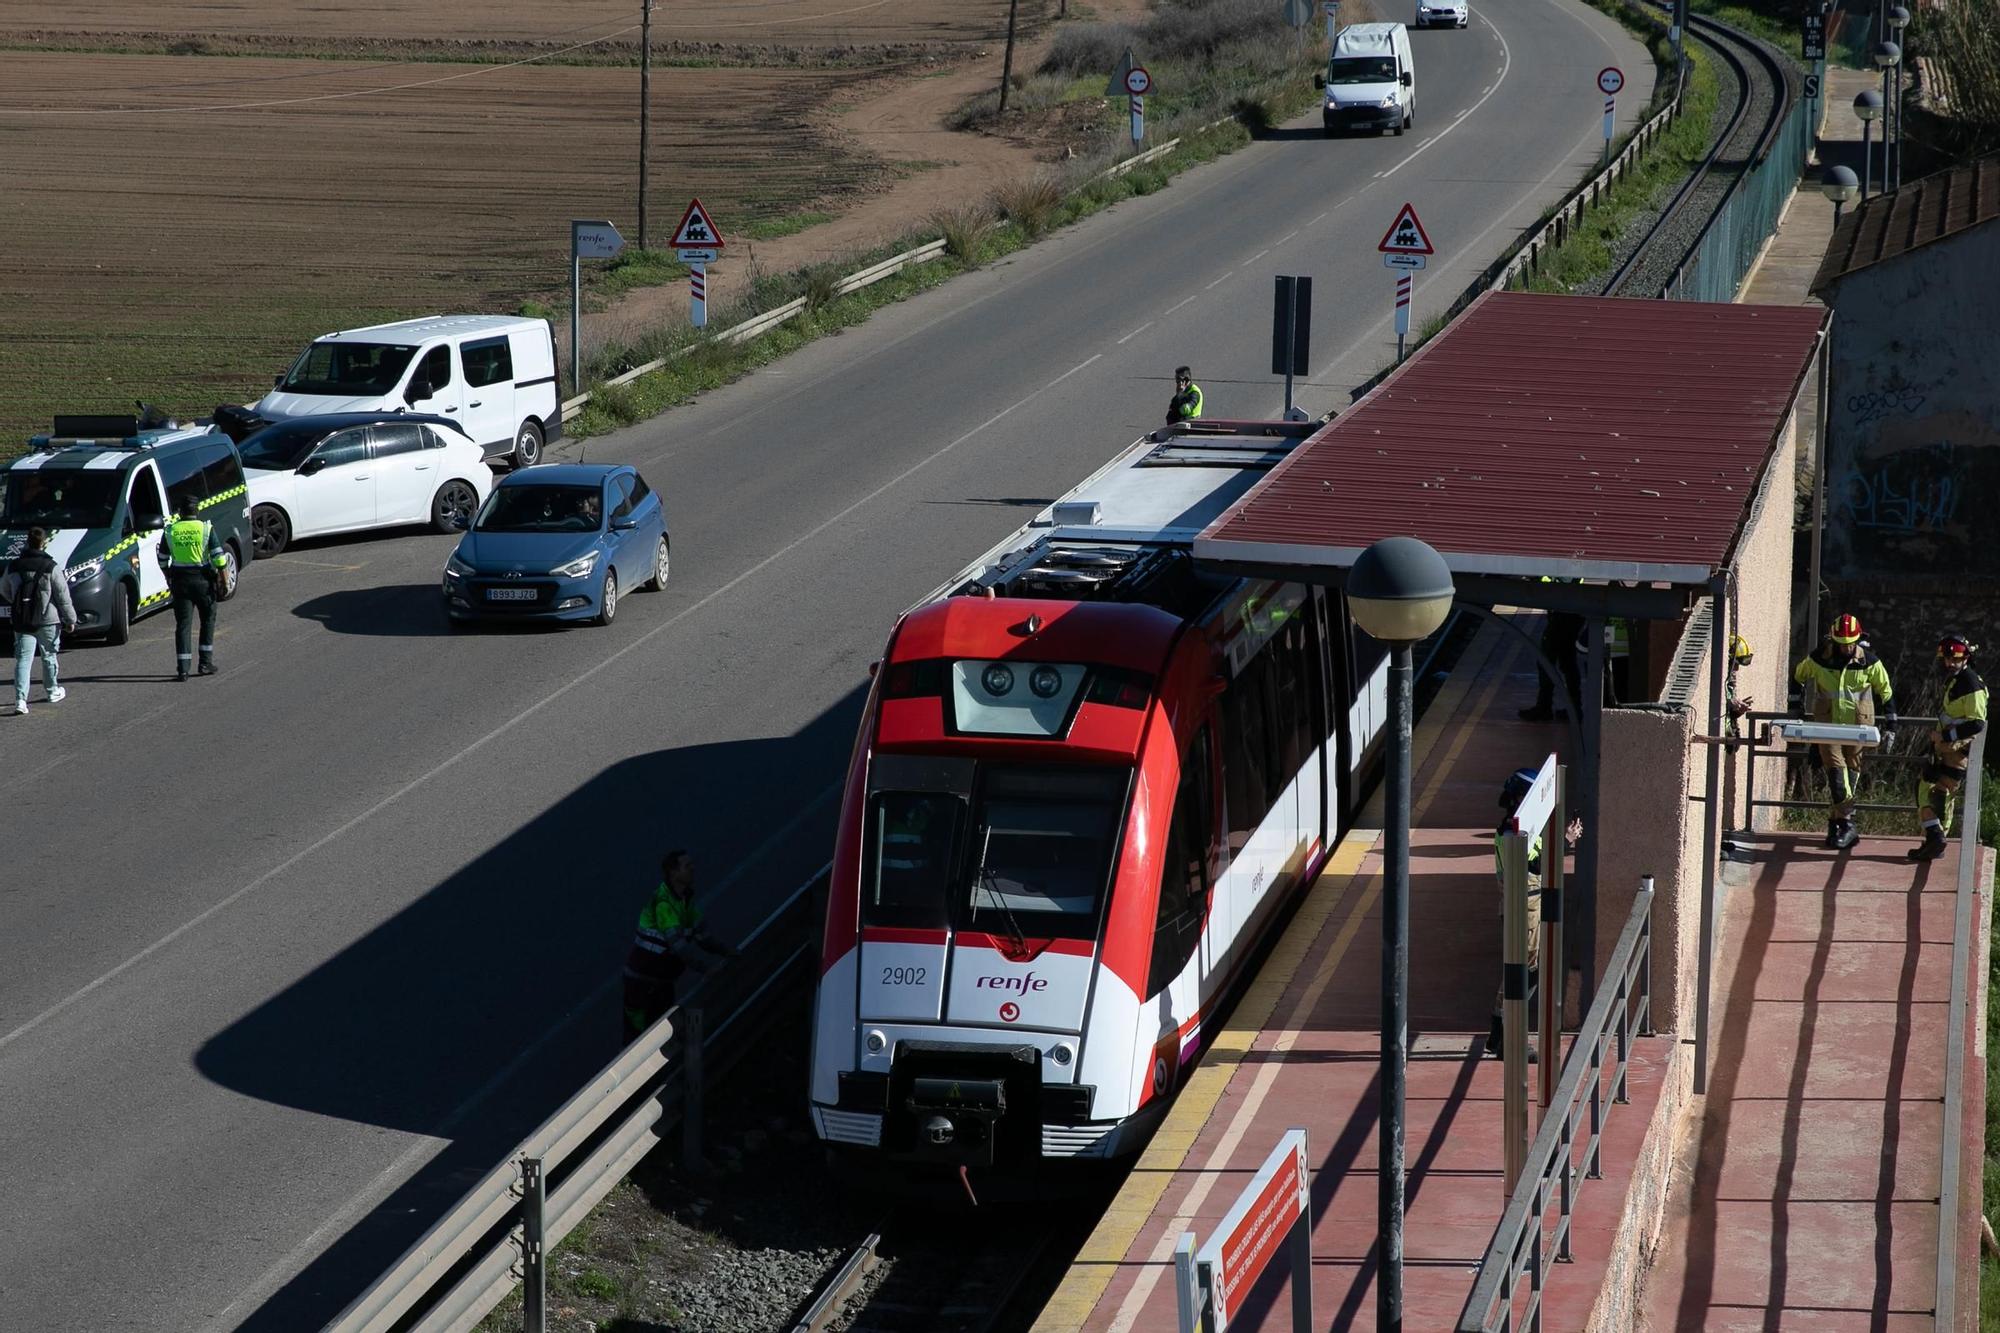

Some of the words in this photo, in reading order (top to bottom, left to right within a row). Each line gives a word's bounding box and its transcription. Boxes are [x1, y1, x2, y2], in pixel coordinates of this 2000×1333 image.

[1806, 76, 1817, 97] S
[578, 234, 605, 246] renfe
[173, 529, 201, 537] GUARDIA
[1251, 862, 1264, 894] renfe
[881, 967, 926, 985] 2902
[976, 971, 1048, 997] renfe
